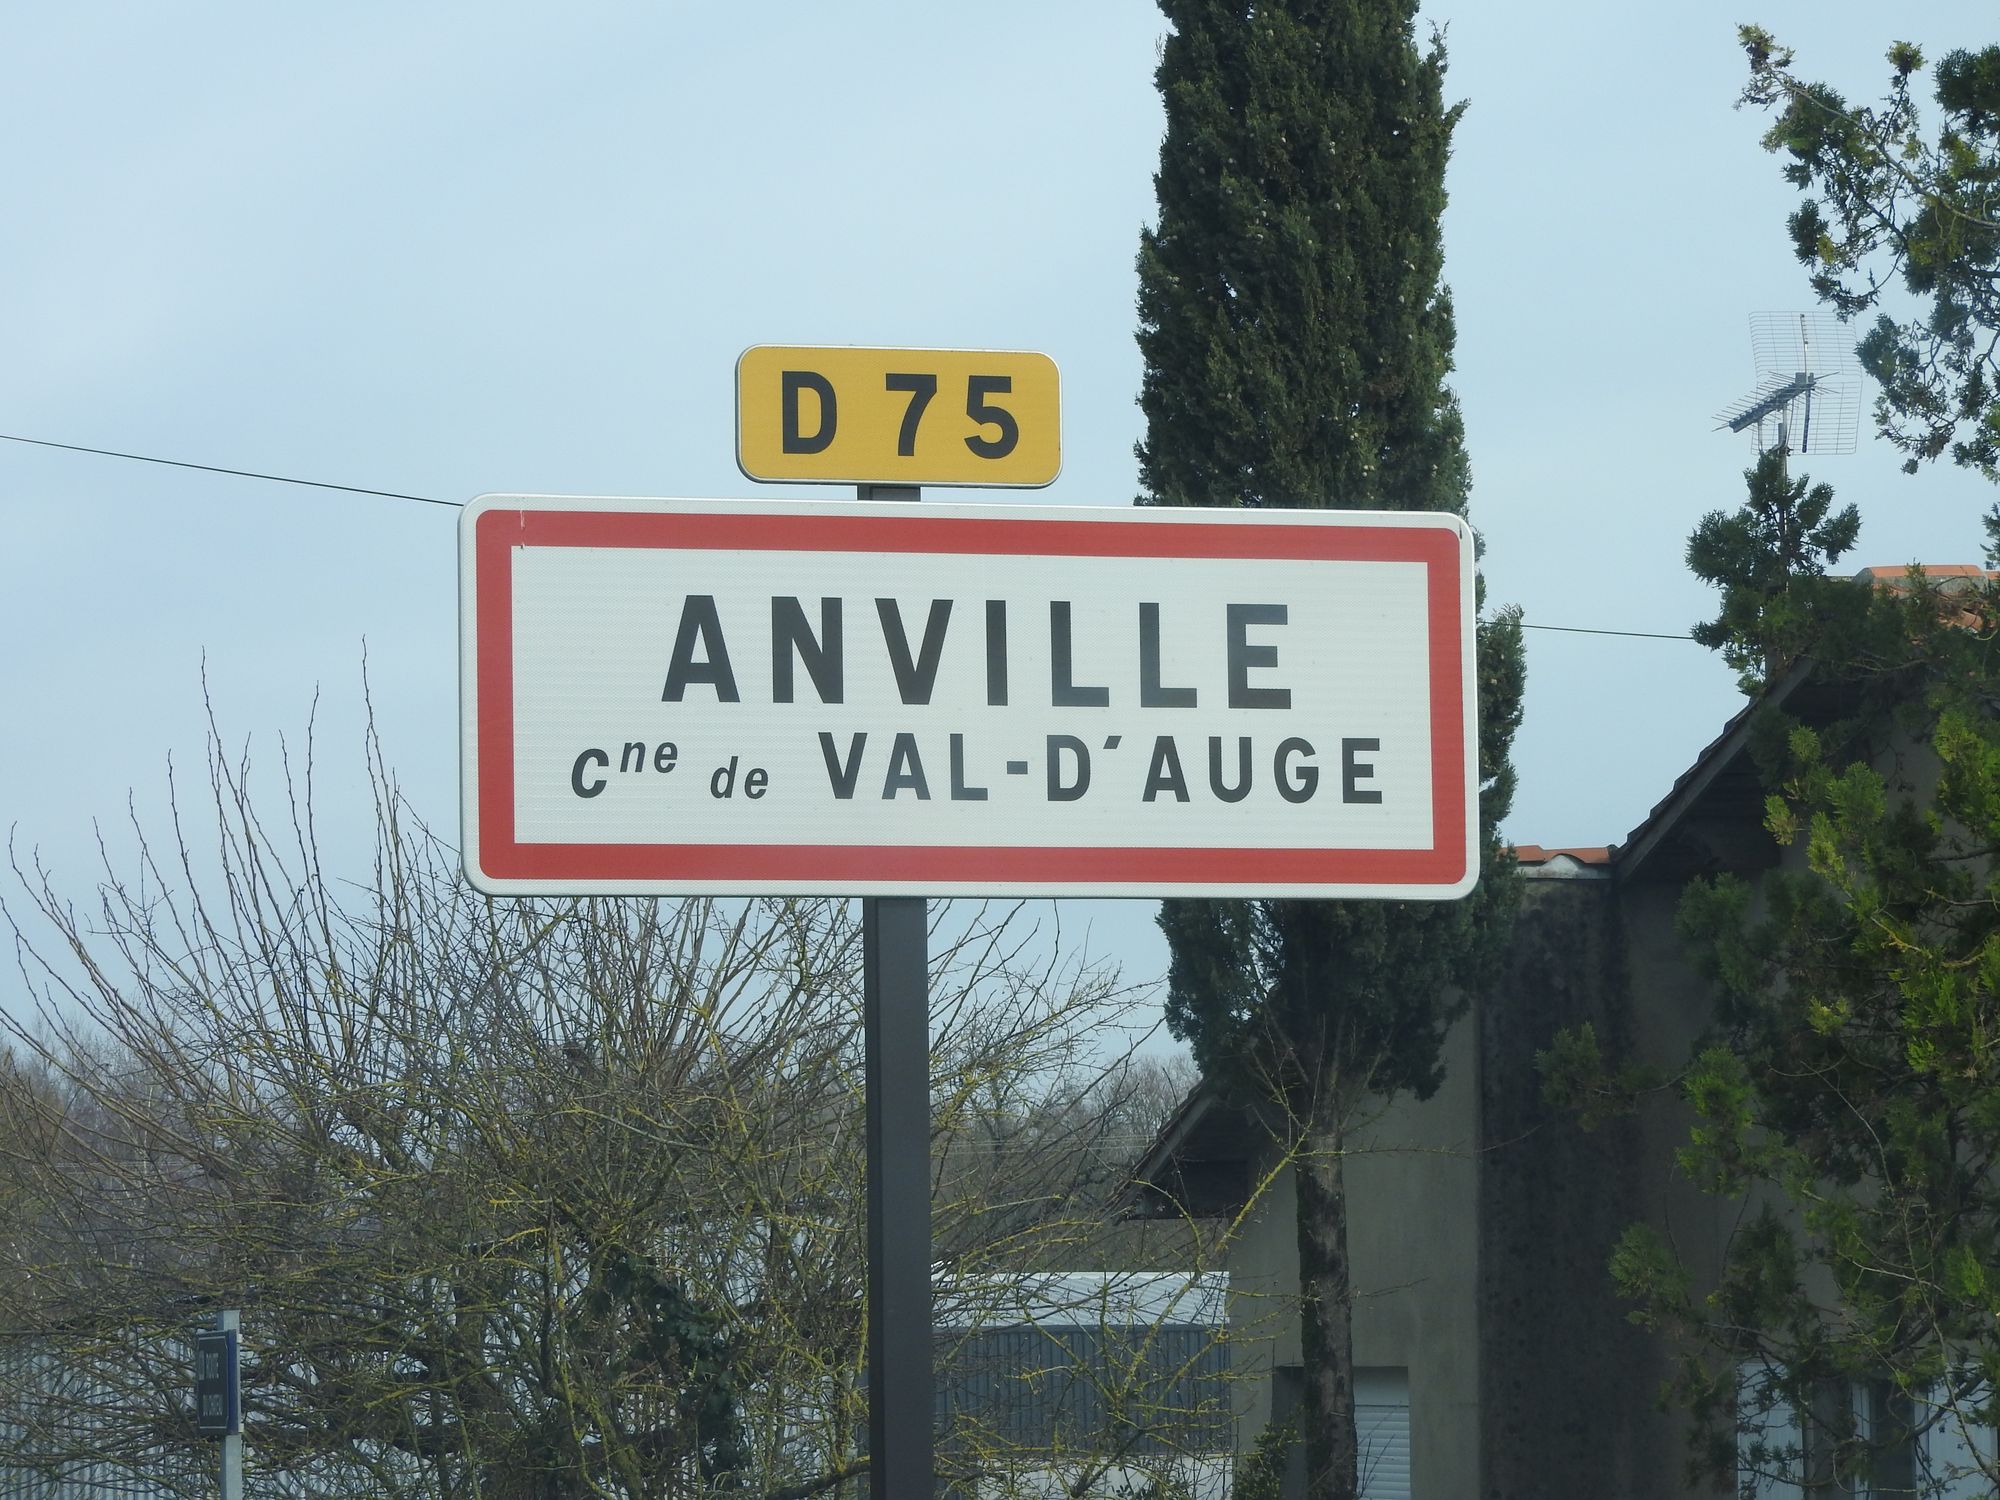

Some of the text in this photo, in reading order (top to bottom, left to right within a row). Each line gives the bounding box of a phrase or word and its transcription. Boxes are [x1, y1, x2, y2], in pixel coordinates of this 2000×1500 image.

[781, 370, 1019, 460] D 75
[661, 594, 1292, 710] ANVILLE
[571, 731, 1383, 804] Cne de VAL-D'AUGE
